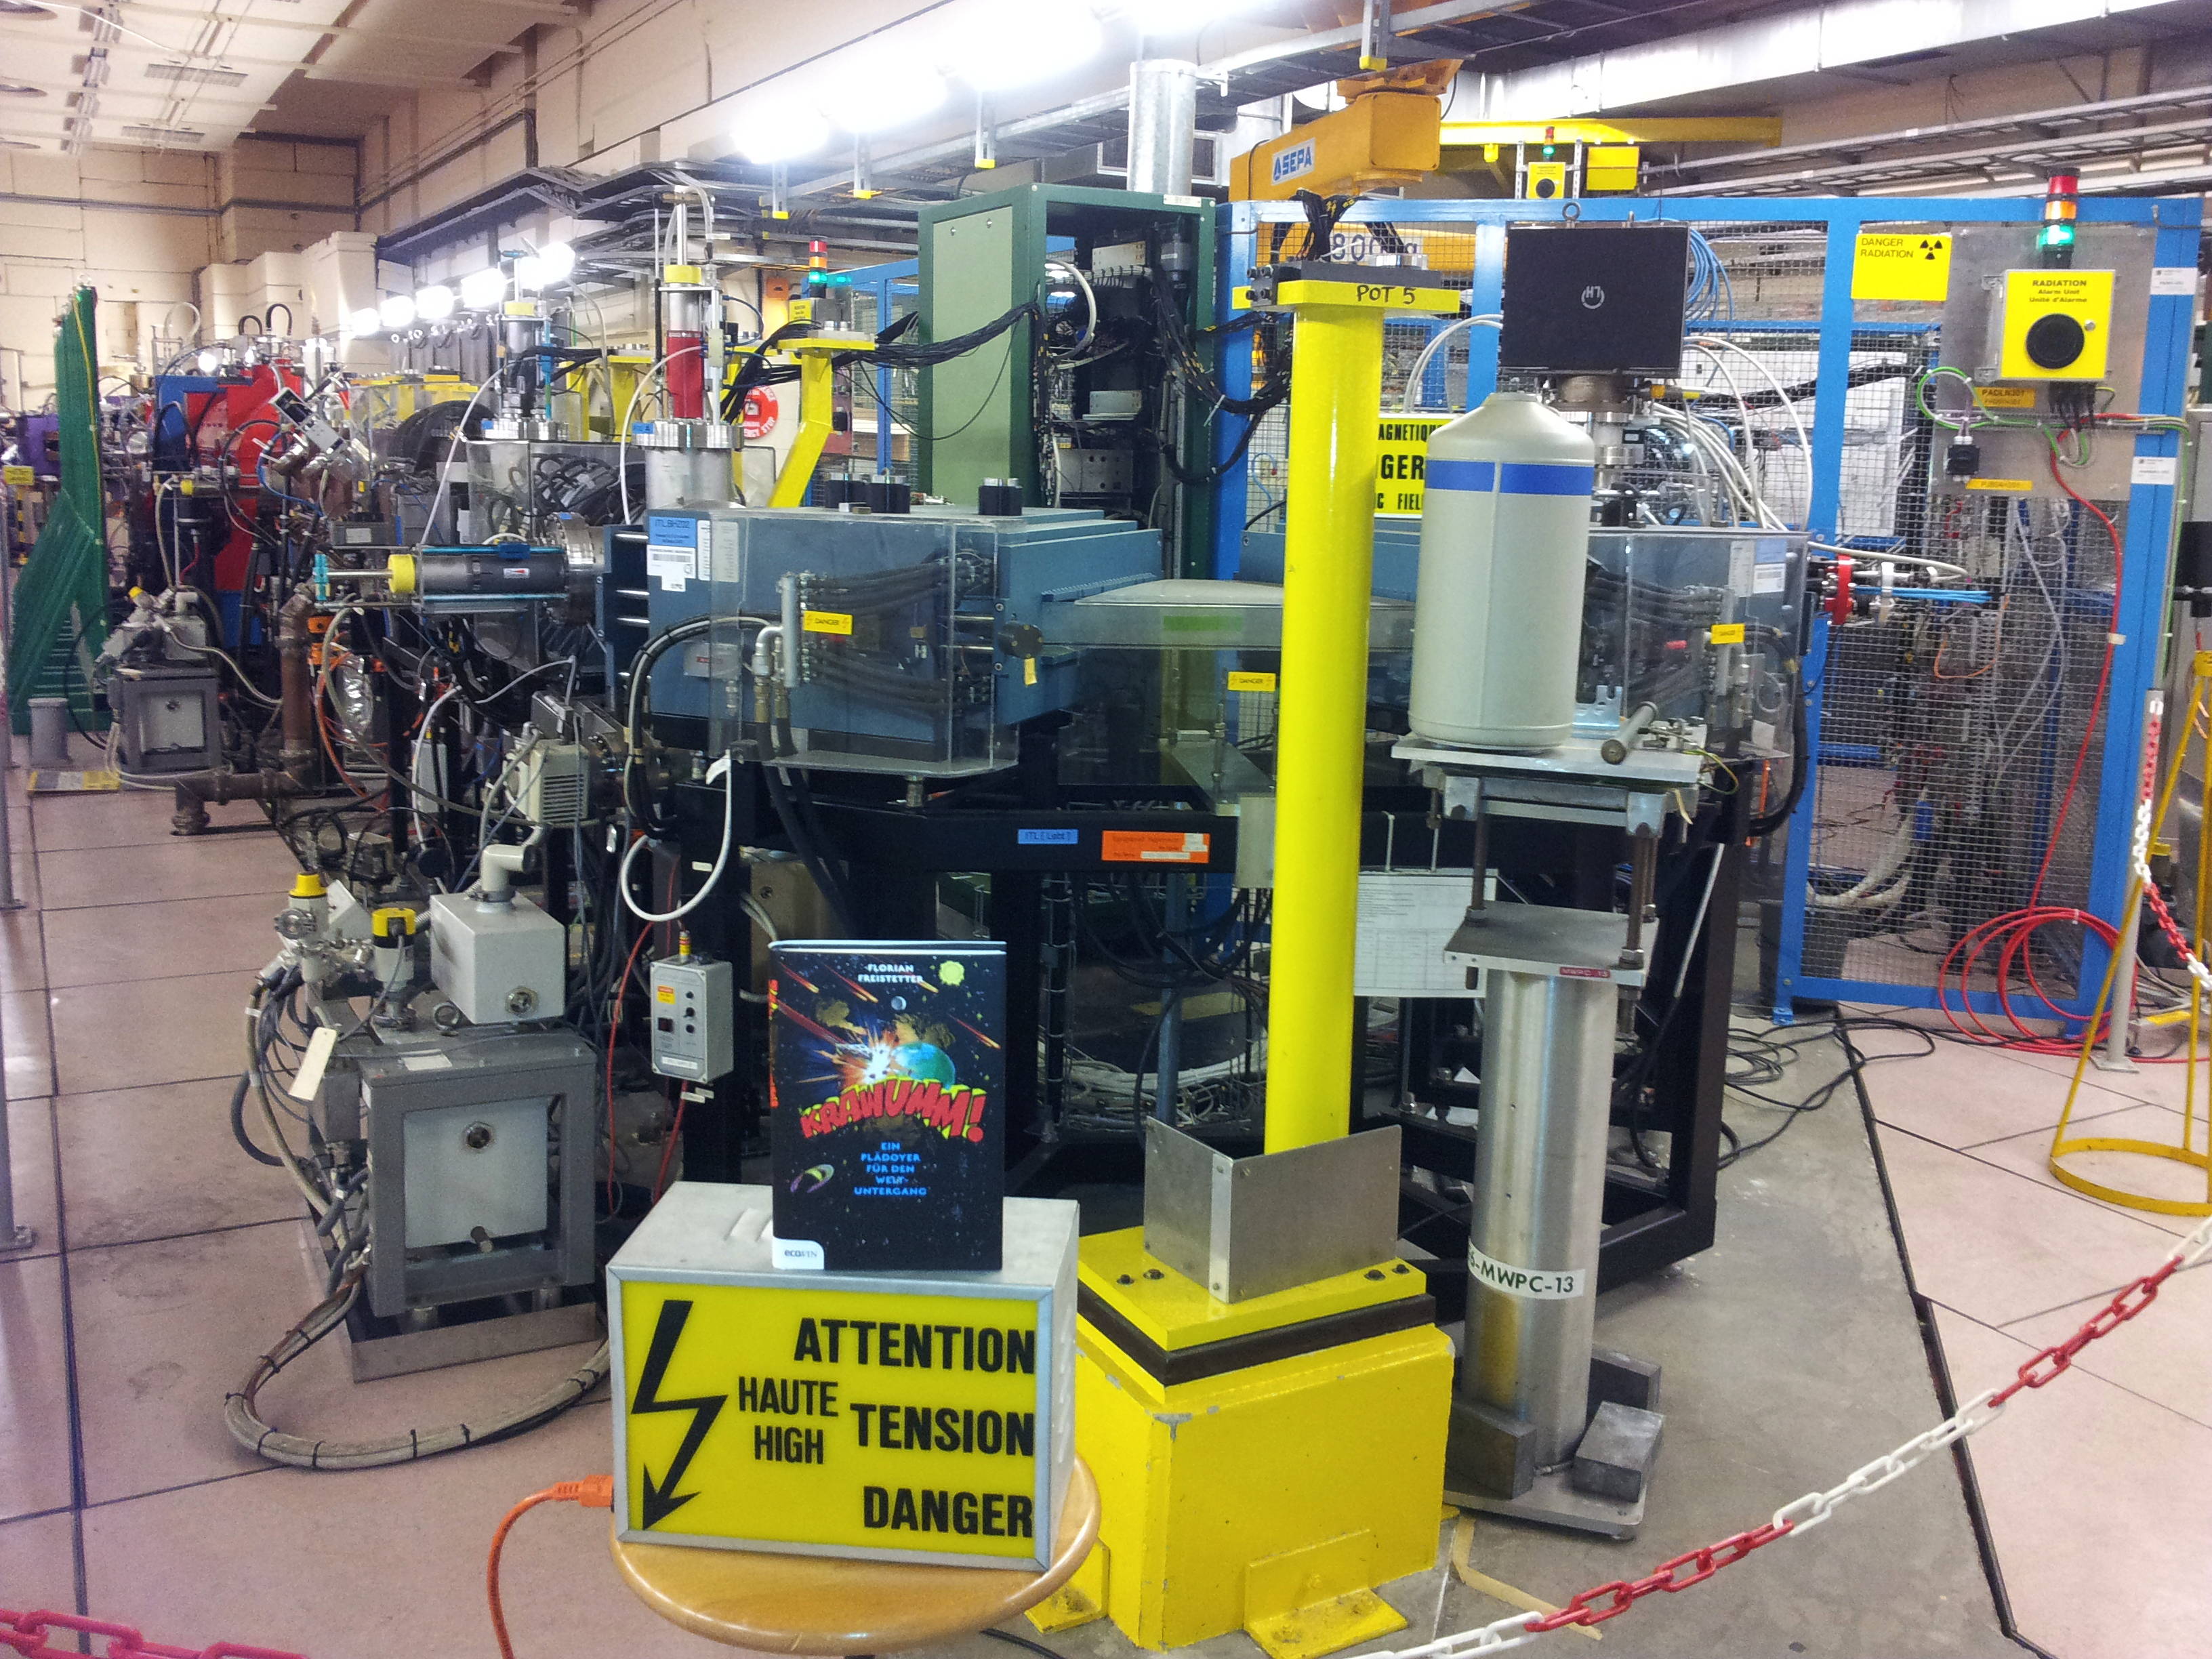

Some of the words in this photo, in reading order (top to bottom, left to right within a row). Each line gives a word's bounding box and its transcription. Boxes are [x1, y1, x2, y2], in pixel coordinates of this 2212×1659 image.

[1861, 238, 1903, 246] DANGER
[1860, 249, 1913, 258] RADIATION
[1357, 285, 1395, 303] POT
[1403, 287, 1416, 305] 5
[1397, 493, 1424, 510] FIEL
[865, 964, 914, 972] FLORIAN
[857, 974, 923, 983] FREISTETTER
[800, 1080, 986, 1142] KRAWUMM!
[880, 1142, 901, 1151] EIN
[861, 1151, 921, 1162] PLÄDOYER
[866, 1163, 888, 1172] FÜR
[890, 1164, 915, 1173] DEN
[854, 1187, 927, 1195] UNTERGANG
[793, 1317, 1036, 1374] ATTENTION
[738, 1376, 838, 1417] HAUTE
[850, 1403, 1034, 1456] TENSION
[754, 1425, 824, 1465] HIGH
[863, 1486, 1033, 1538] DANGER
